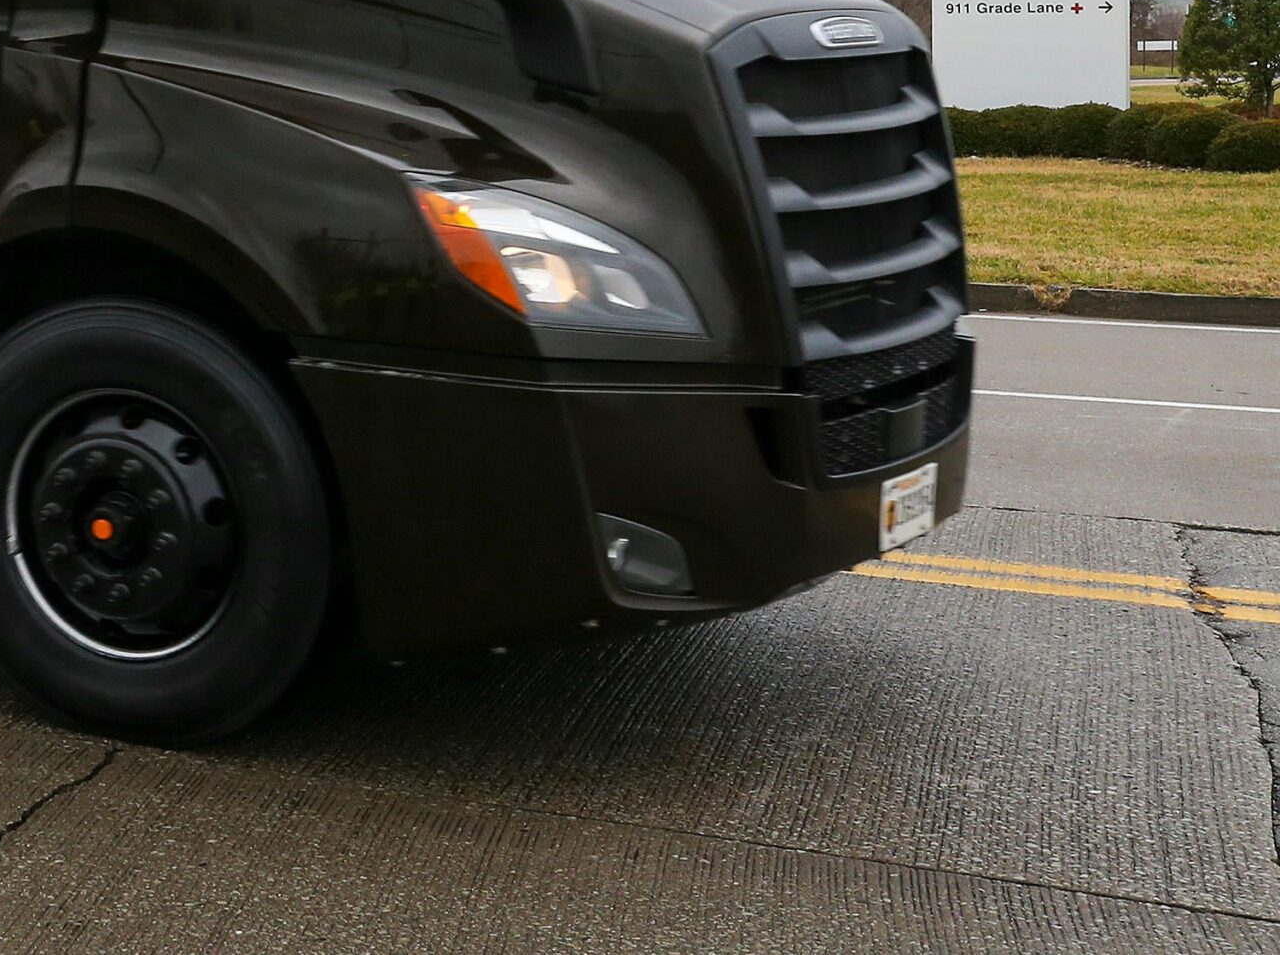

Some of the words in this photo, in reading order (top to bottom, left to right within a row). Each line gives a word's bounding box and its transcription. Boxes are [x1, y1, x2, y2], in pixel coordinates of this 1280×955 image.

[946, 3, 970, 14] 911
[976, 2, 1022, 14] Grade
[1027, 2, 1064, 14] Lane
